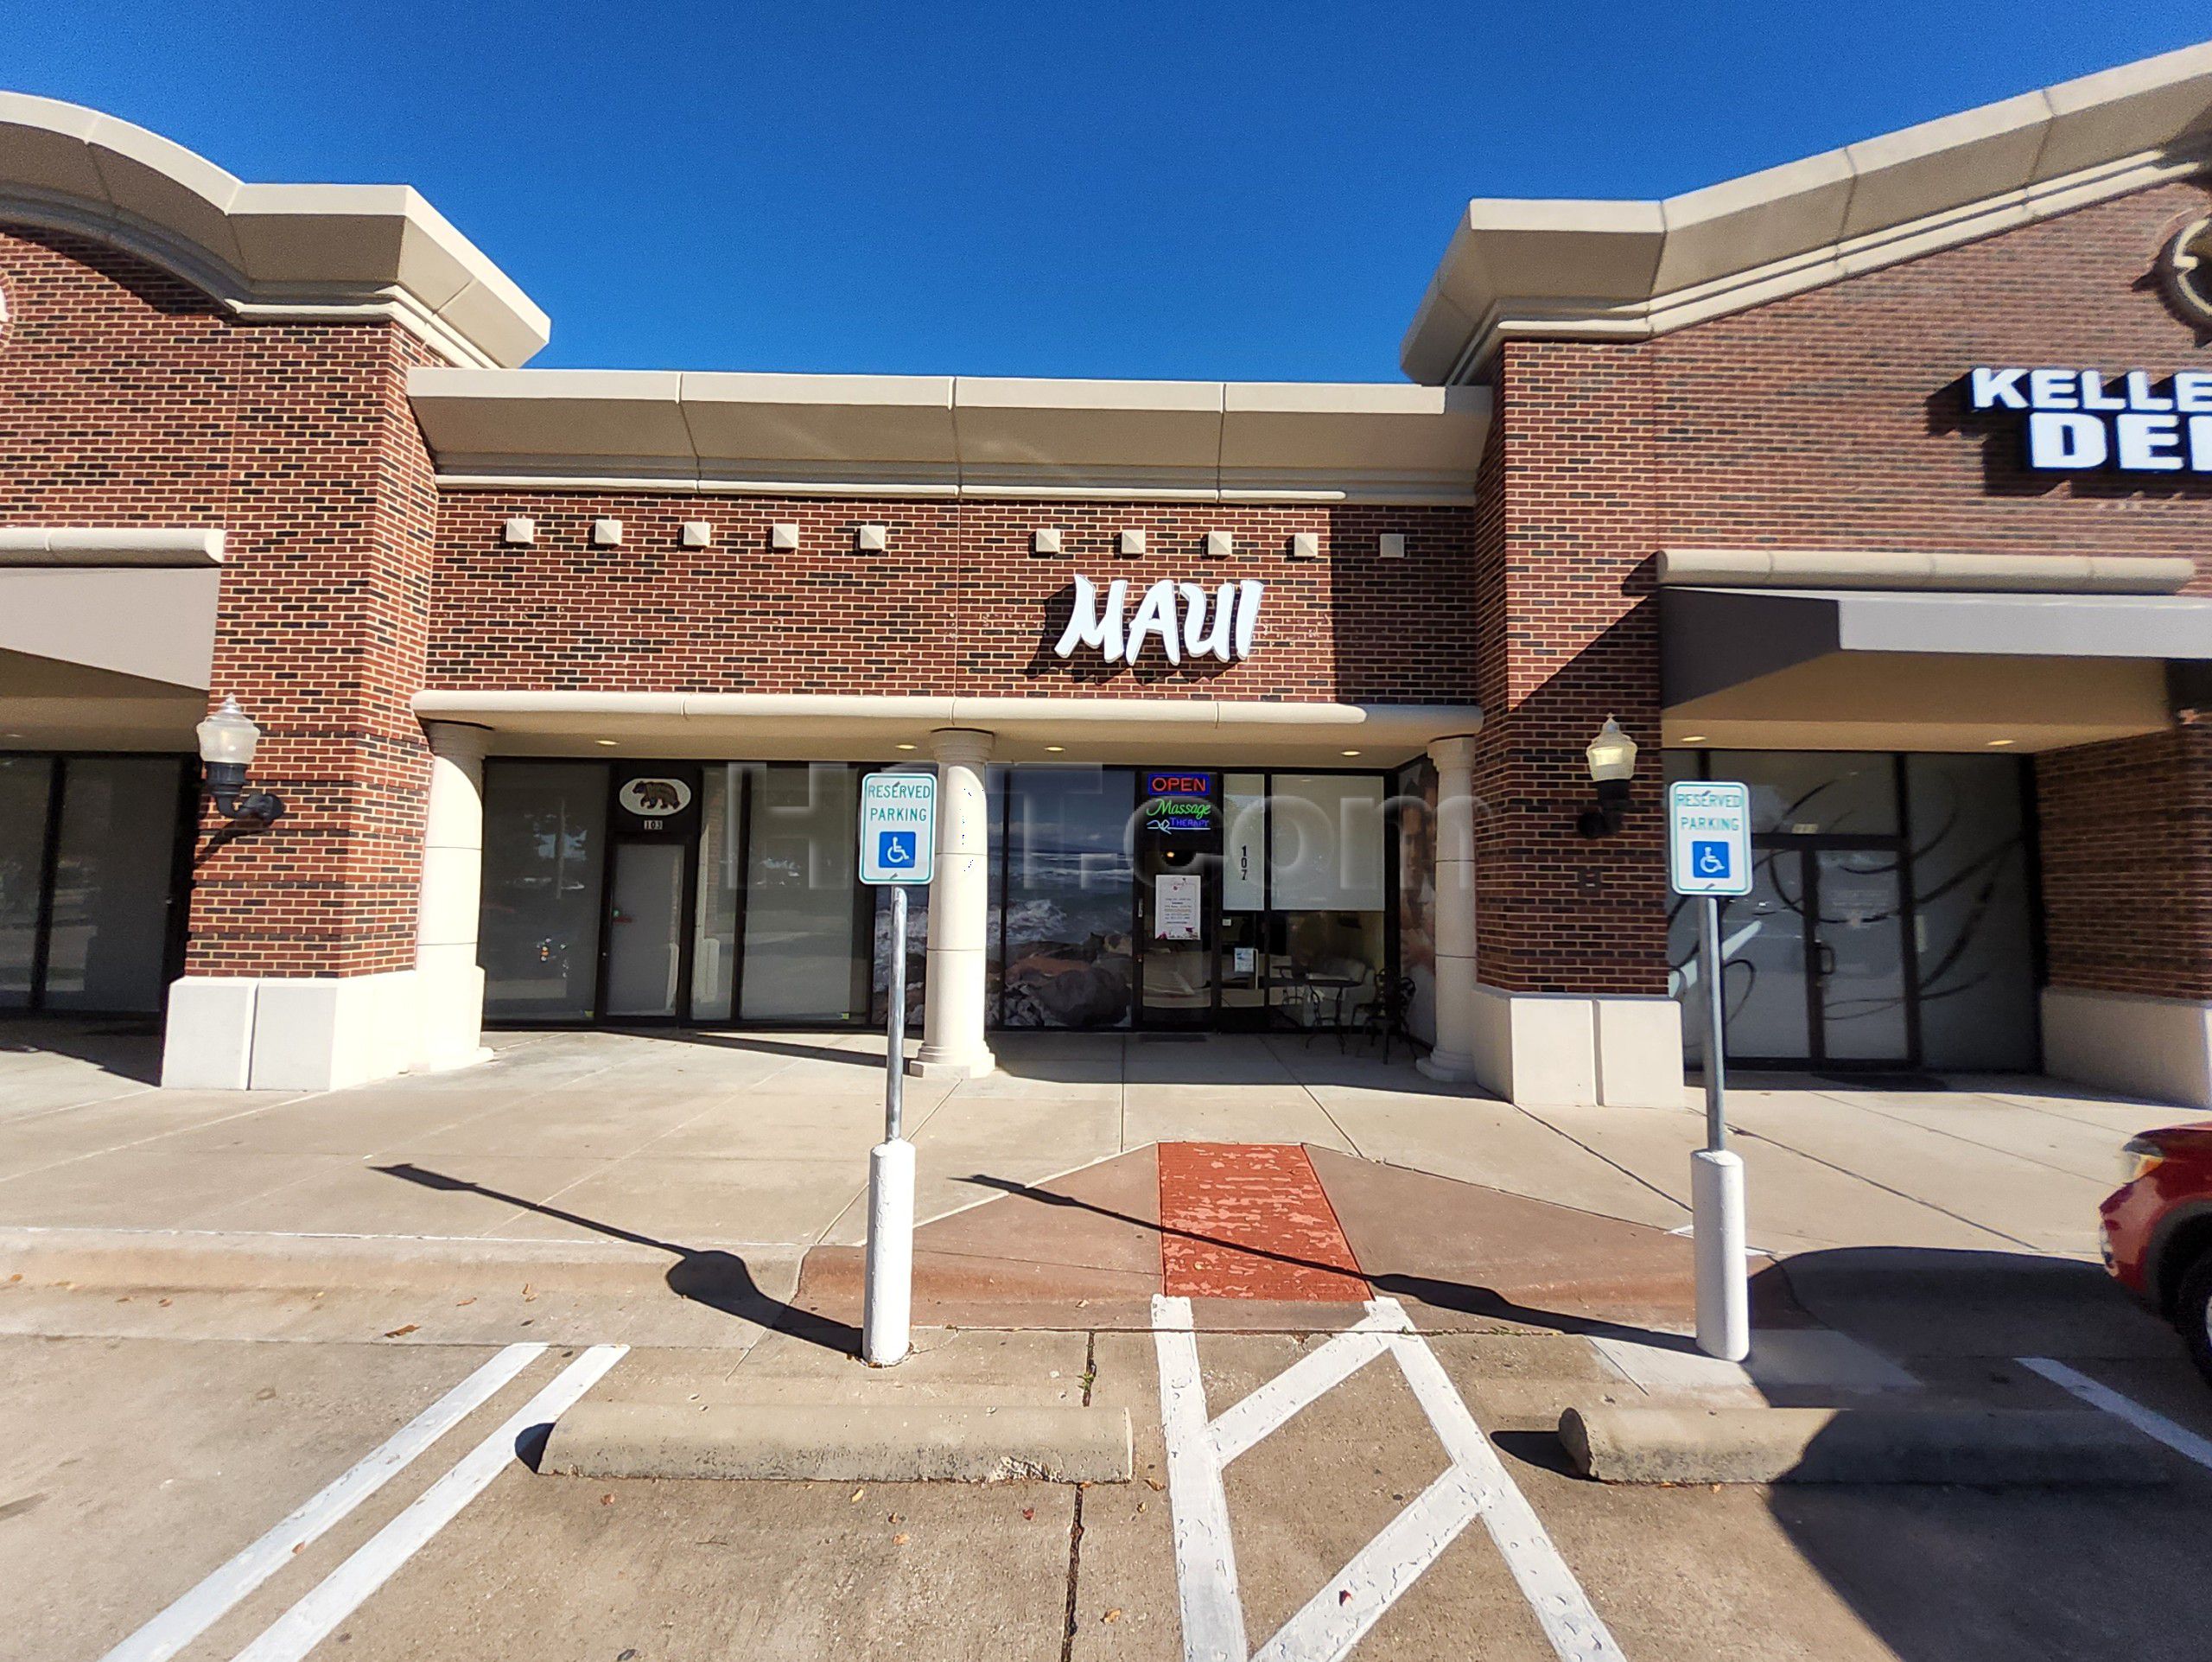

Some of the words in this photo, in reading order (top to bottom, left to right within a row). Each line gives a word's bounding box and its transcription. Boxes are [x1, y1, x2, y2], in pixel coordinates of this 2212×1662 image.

[1971, 367, 2212, 412] KELLE
[1054, 574, 1264, 666] MAUI
[868, 785, 931, 799] RESERVED
[1152, 777, 1205, 792] OPEN
[1676, 793, 1742, 807] RESERVED
[870, 807, 927, 822] PARKING
[1146, 799, 1211, 820] Massage
[1169, 817, 1210, 827] THERAPY
[1681, 817, 1739, 831] PARKING
